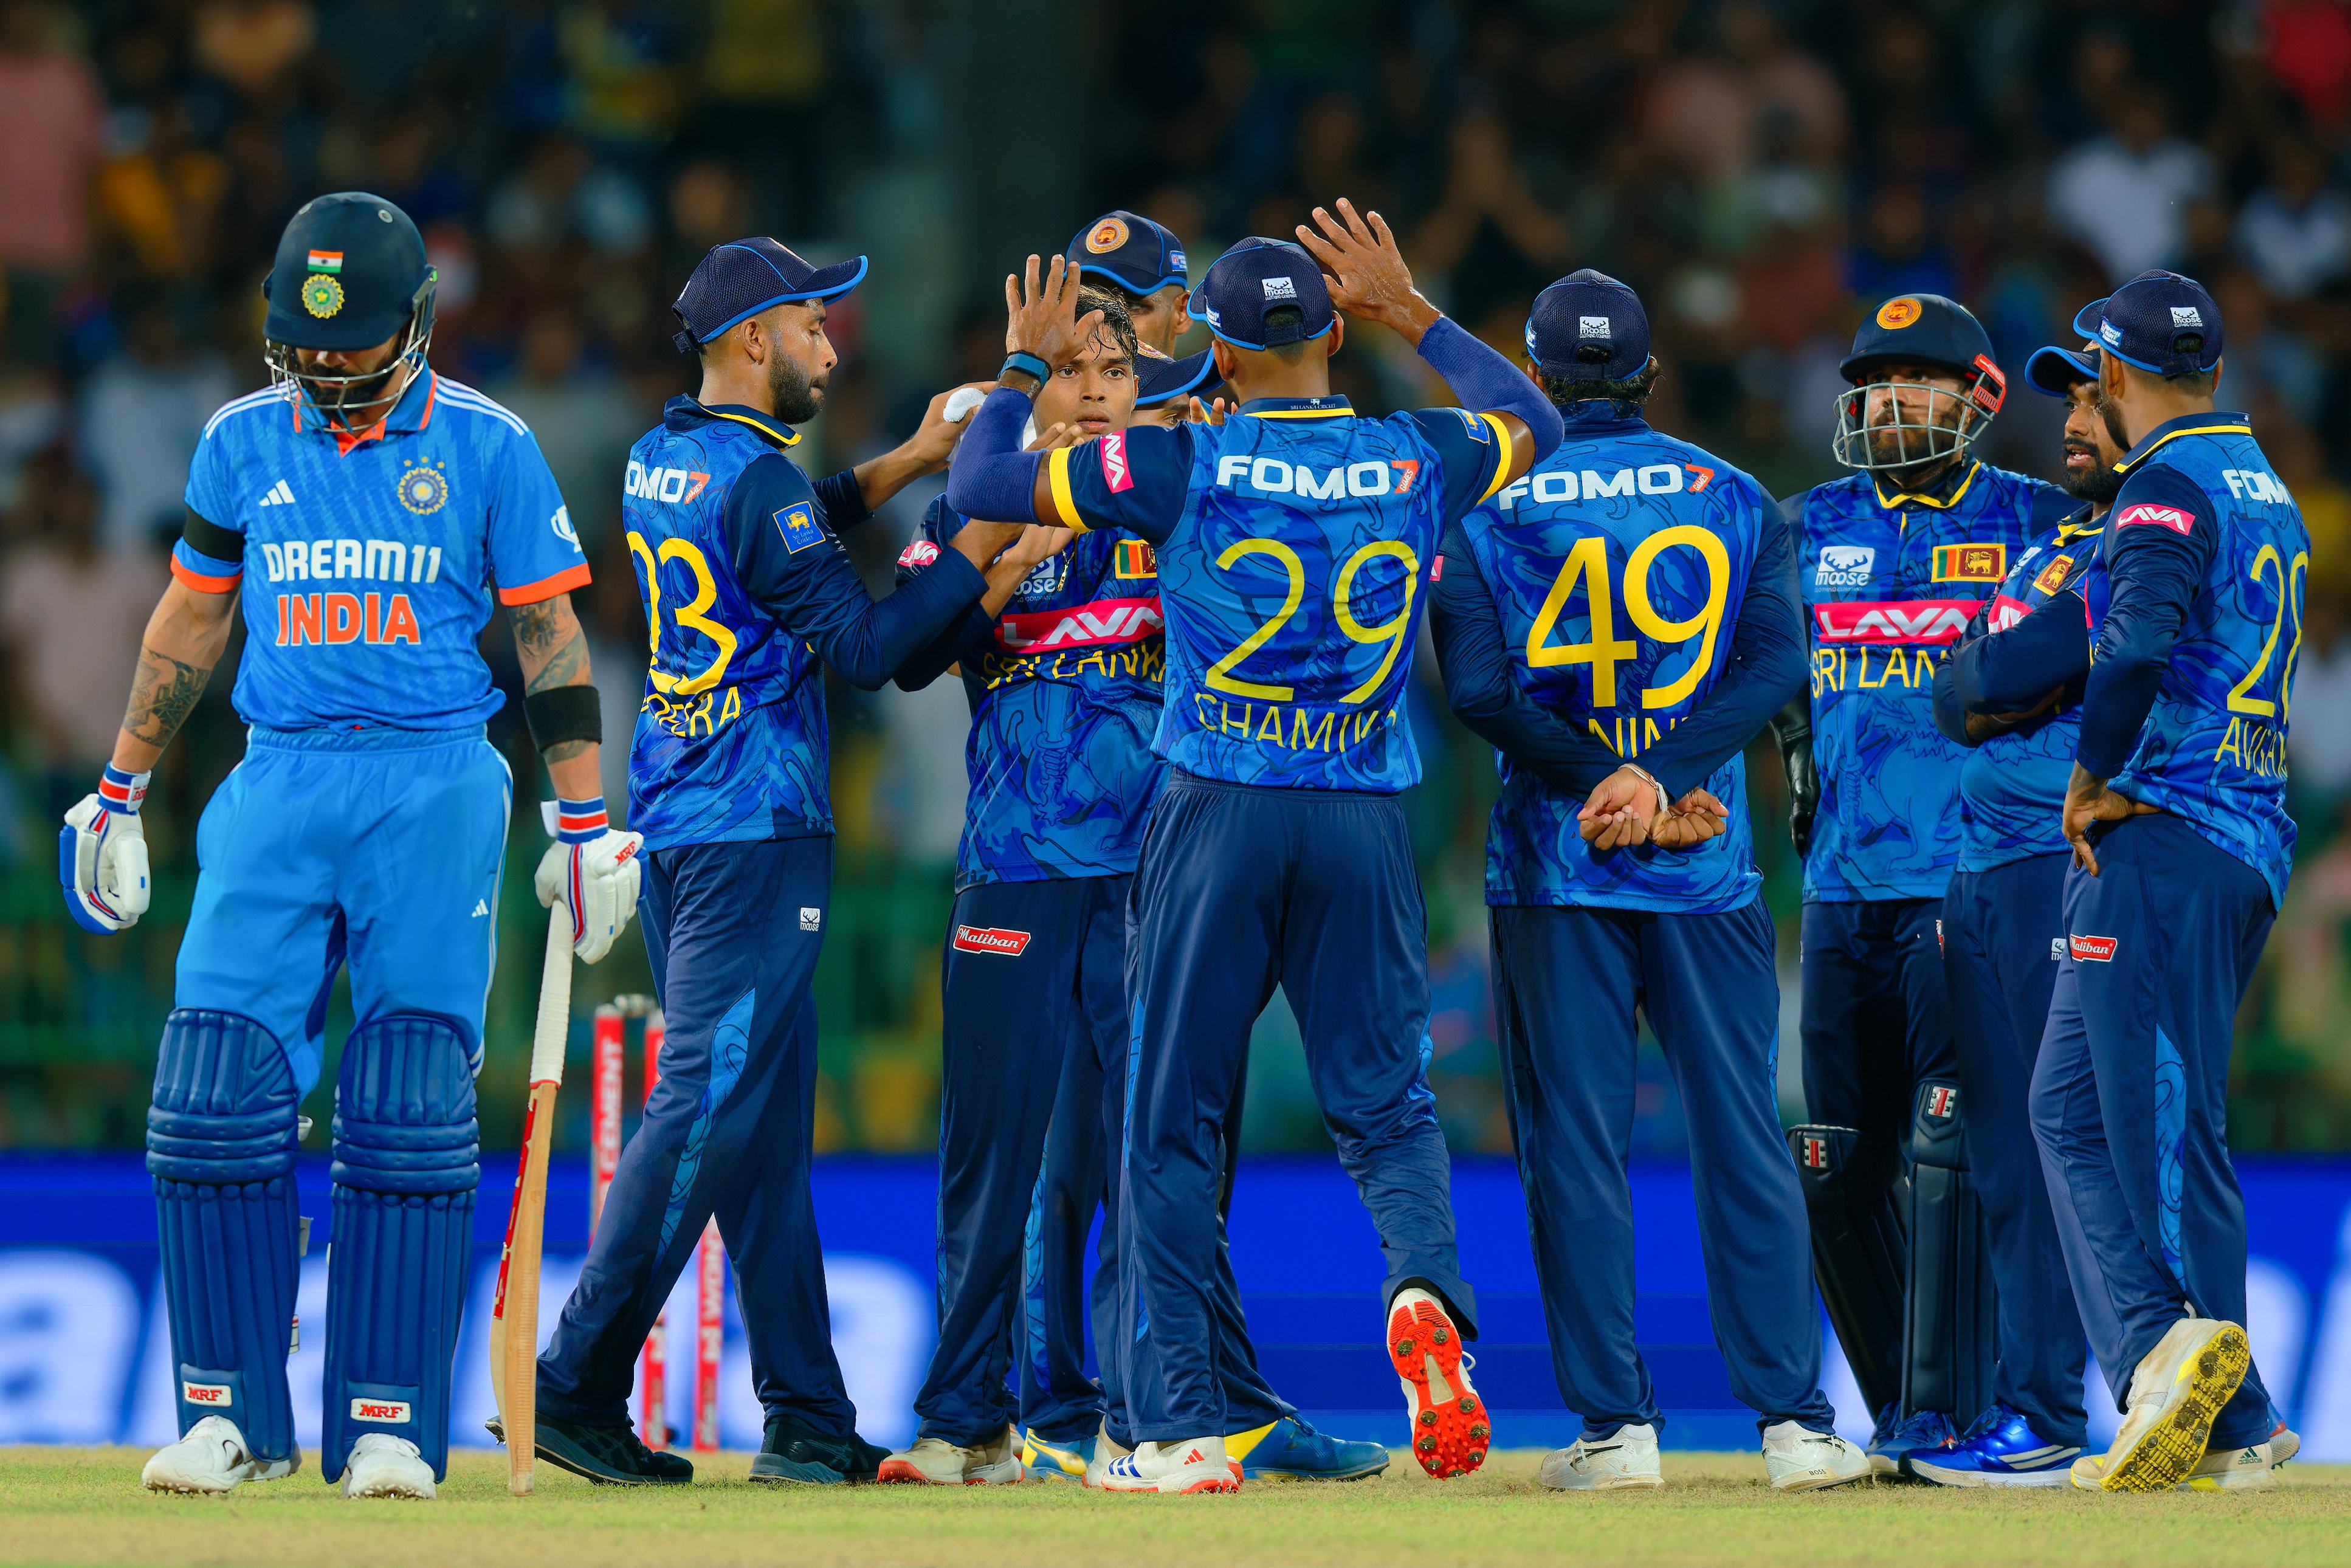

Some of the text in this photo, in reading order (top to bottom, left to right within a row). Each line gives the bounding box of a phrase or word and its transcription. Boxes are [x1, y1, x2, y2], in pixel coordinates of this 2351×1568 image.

[1264, 288, 1296, 297] moose
[1100, 432, 1125, 489] AVA
[624, 459, 711, 504] OMO7
[1216, 455, 1419, 500] FOMO7
[2222, 469, 2294, 506] FOM
[2118, 506, 2186, 532] LAVA
[261, 539, 442, 583] DREAM11
[1013, 578, 1056, 596] oose
[1815, 571, 1869, 586] moose
[275, 591, 422, 646] INDIA
[1003, 607, 1165, 647] LAVA
[1205, 537, 1420, 704] 29
[1526, 524, 1730, 709] 49
[1819, 607, 1971, 637] LAVA
[1811, 645, 1947, 699] SRI LAN
[614, 840, 636, 866] MRF
[800, 922, 819, 932] moose
[958, 927, 1019, 949] Maliban
[2070, 937, 2109, 955] Maliban
[188, 1386, 222, 1401] MRF
[359, 1403, 404, 1419] MRF
